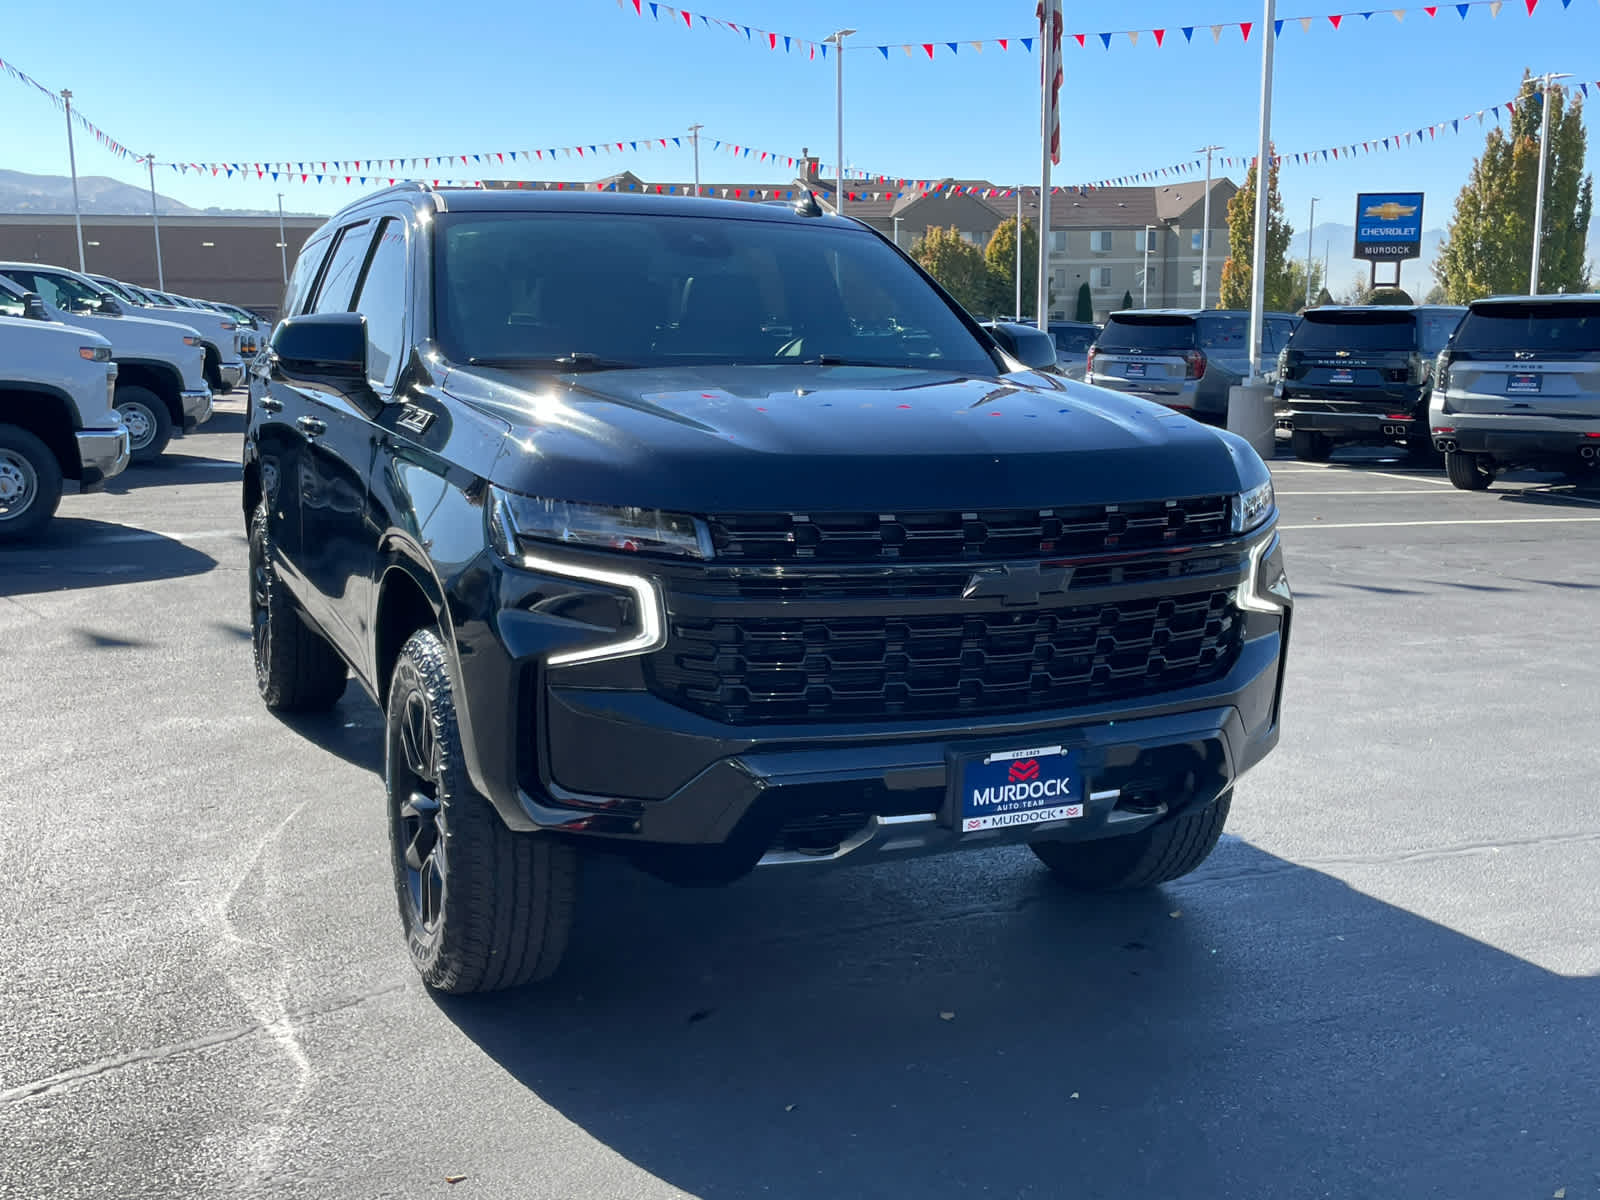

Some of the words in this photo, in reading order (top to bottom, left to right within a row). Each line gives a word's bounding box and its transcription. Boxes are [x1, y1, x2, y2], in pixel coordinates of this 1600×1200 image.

[1361, 228, 1416, 236] CHEVROLET
[973, 777, 1070, 807] MURDOCK
[997, 803, 1020, 812] AUTO
[1023, 799, 1045, 809] TEAM
[991, 809, 1056, 827] MURDOCK
